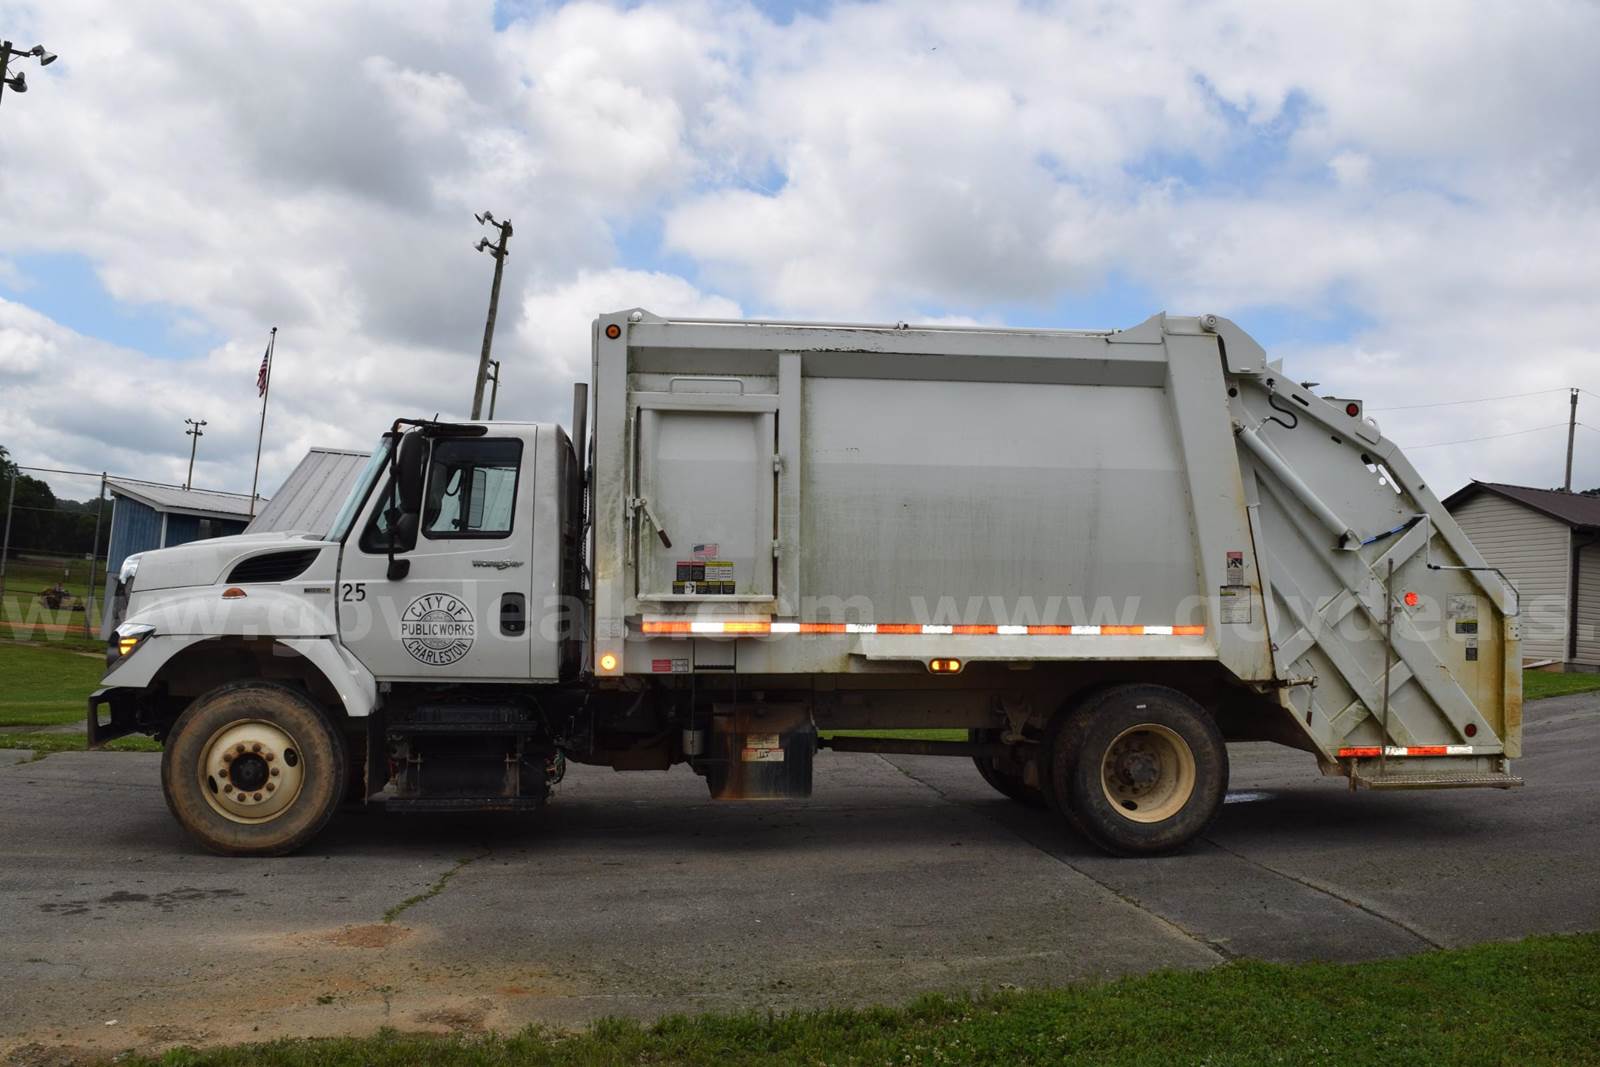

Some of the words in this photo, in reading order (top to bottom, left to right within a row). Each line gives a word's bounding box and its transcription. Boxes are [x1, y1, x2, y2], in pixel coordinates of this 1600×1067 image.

[342, 582, 366, 602] 25
[410, 596, 443, 618] CITY
[446, 600, 467, 616] OF
[407, 640, 468, 664] CHARLESTON
